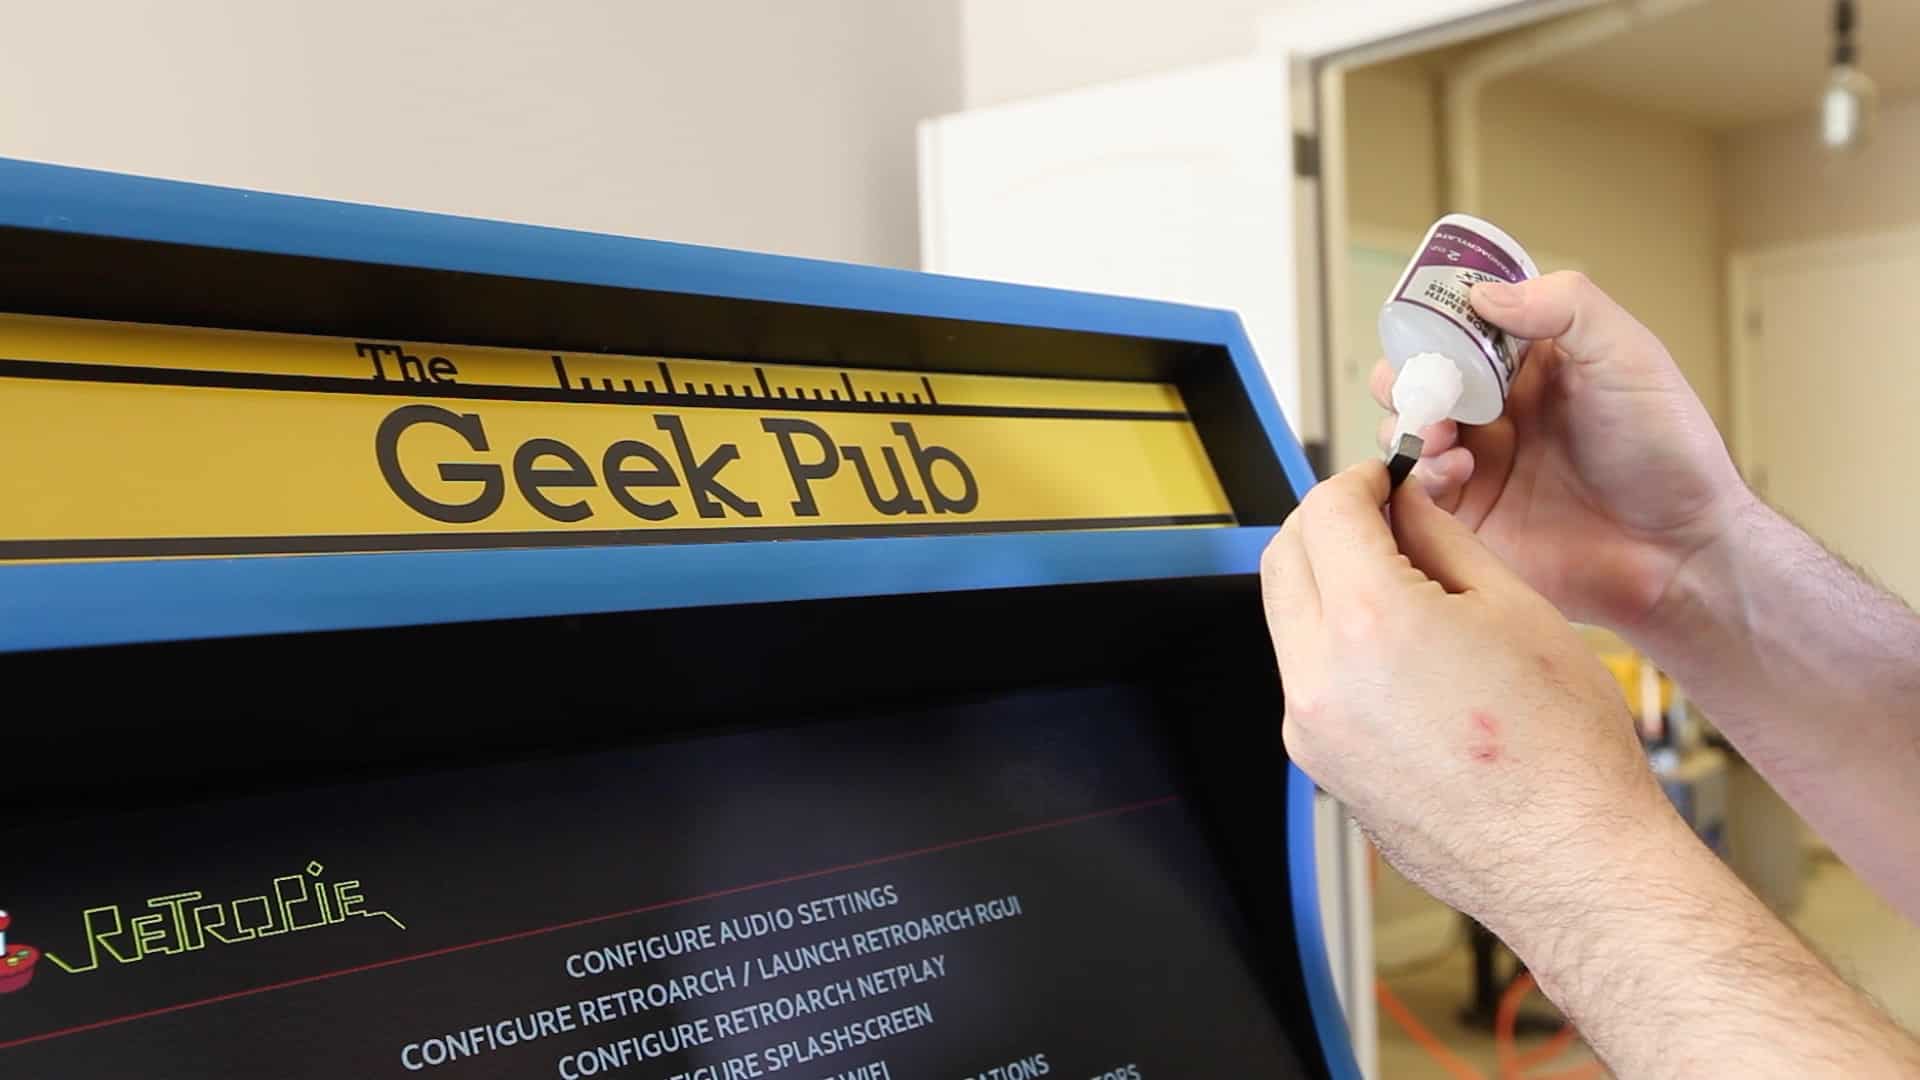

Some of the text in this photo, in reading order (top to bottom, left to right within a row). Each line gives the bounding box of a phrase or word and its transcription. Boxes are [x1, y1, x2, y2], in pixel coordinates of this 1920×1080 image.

[1424, 289, 1463, 315] SMITH
[355, 342, 459, 384] The
[375, 404, 980, 524] Geek Pub
[566, 884, 899, 979] CONFIGURE AUDIO SETTINGS
[401, 1005, 577, 1071] CONFIGURE
[578, 965, 737, 1026] RETROARCH
[757, 936, 851, 980] LAUNCH
[852, 907, 976, 957] RETROARCH
[974, 895, 1023, 926] RGUI
[558, 954, 948, 1080] CONFIGURE RETROARCH NETPLAY
[764, 1003, 934, 1073] SPLASHSCREEN
